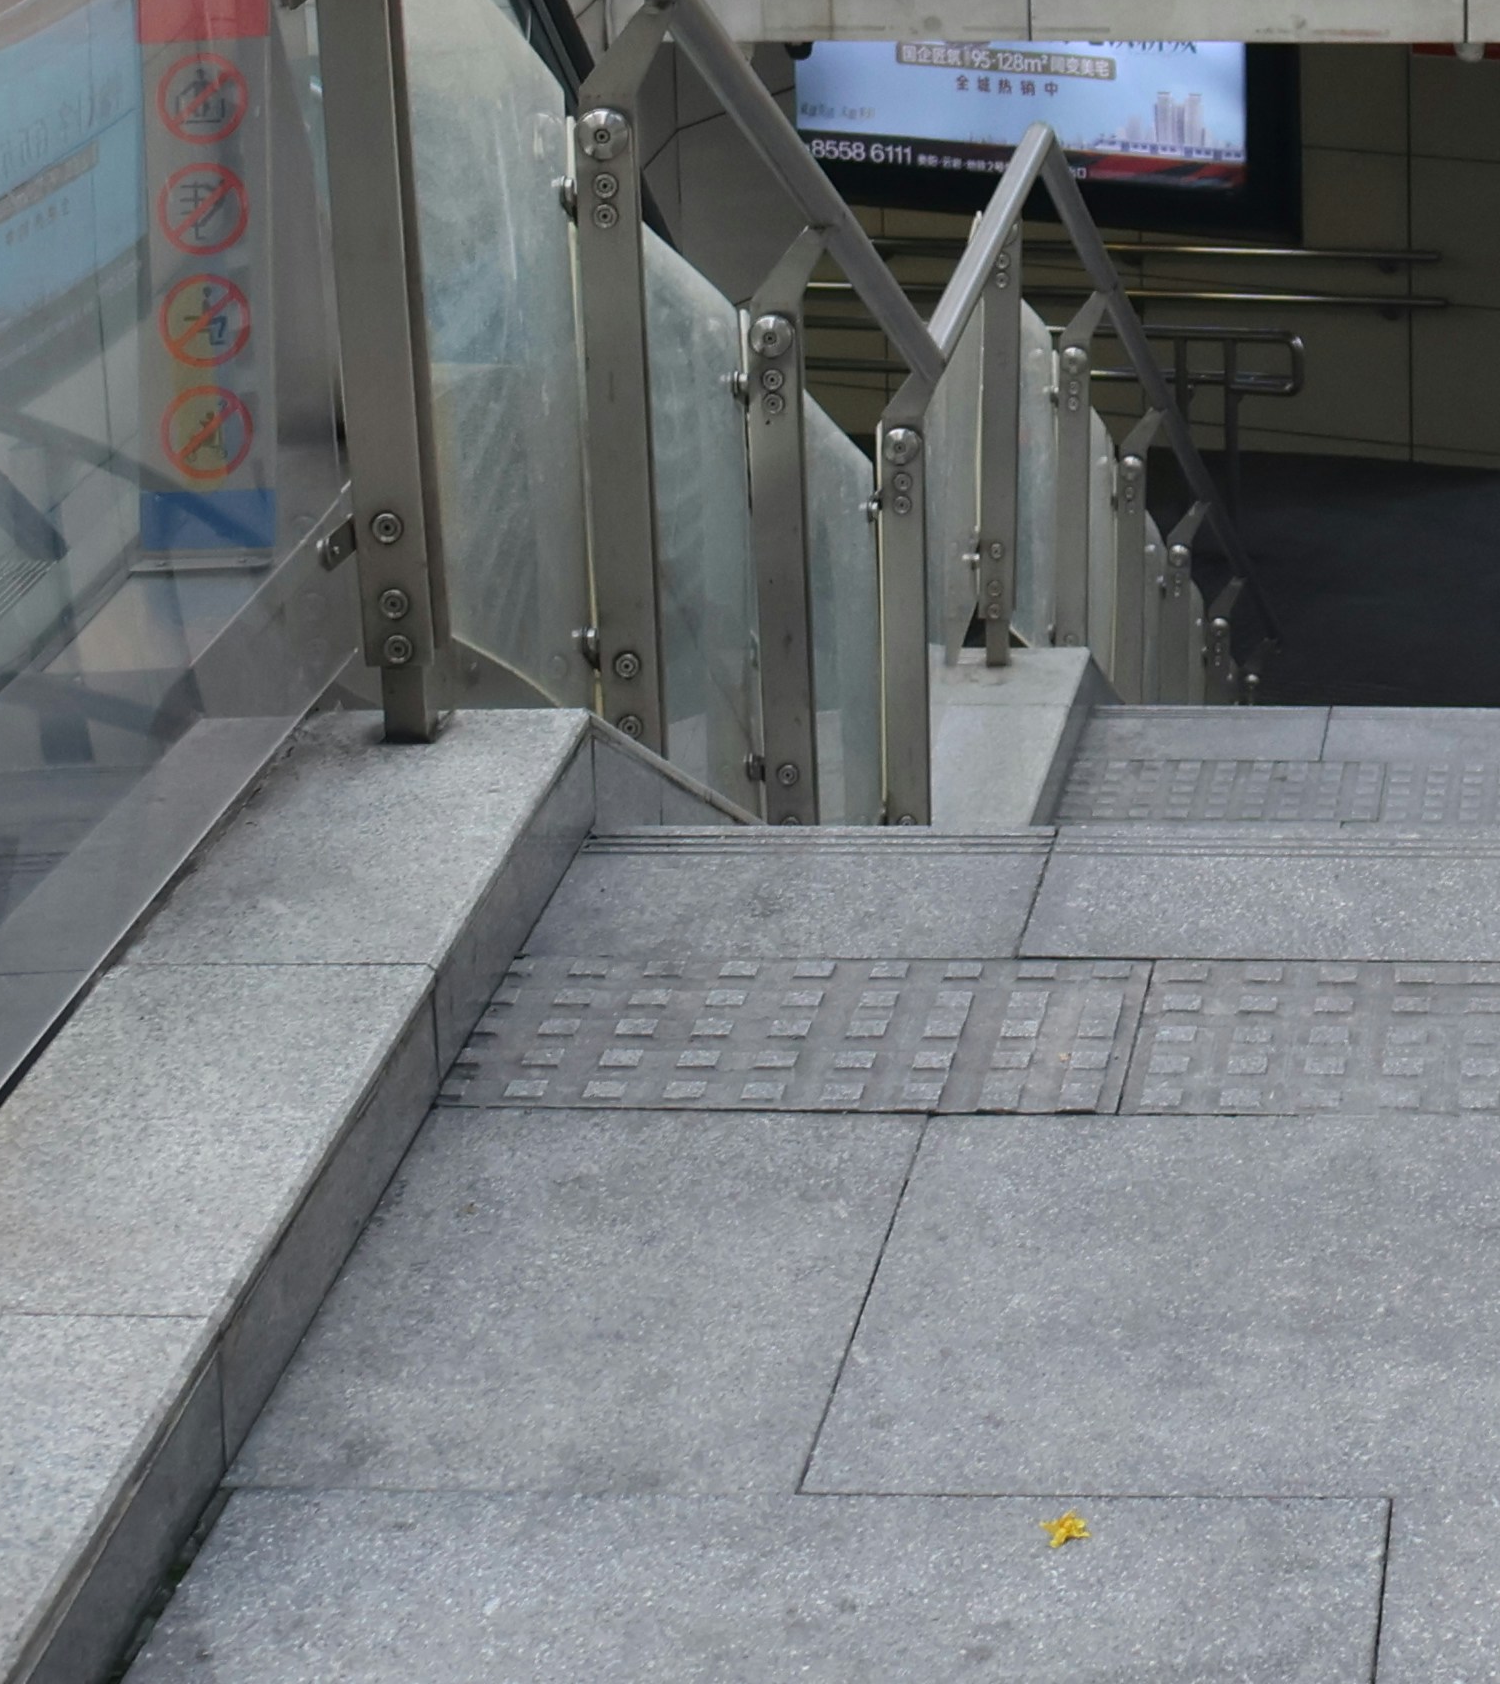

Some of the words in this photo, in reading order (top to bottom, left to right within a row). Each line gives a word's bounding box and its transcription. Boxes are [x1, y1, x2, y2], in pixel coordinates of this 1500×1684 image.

[955, 74, 1059, 98] 全城热销中
[811, 138, 867, 163] 8558
[869, 142, 913, 166] 6111
